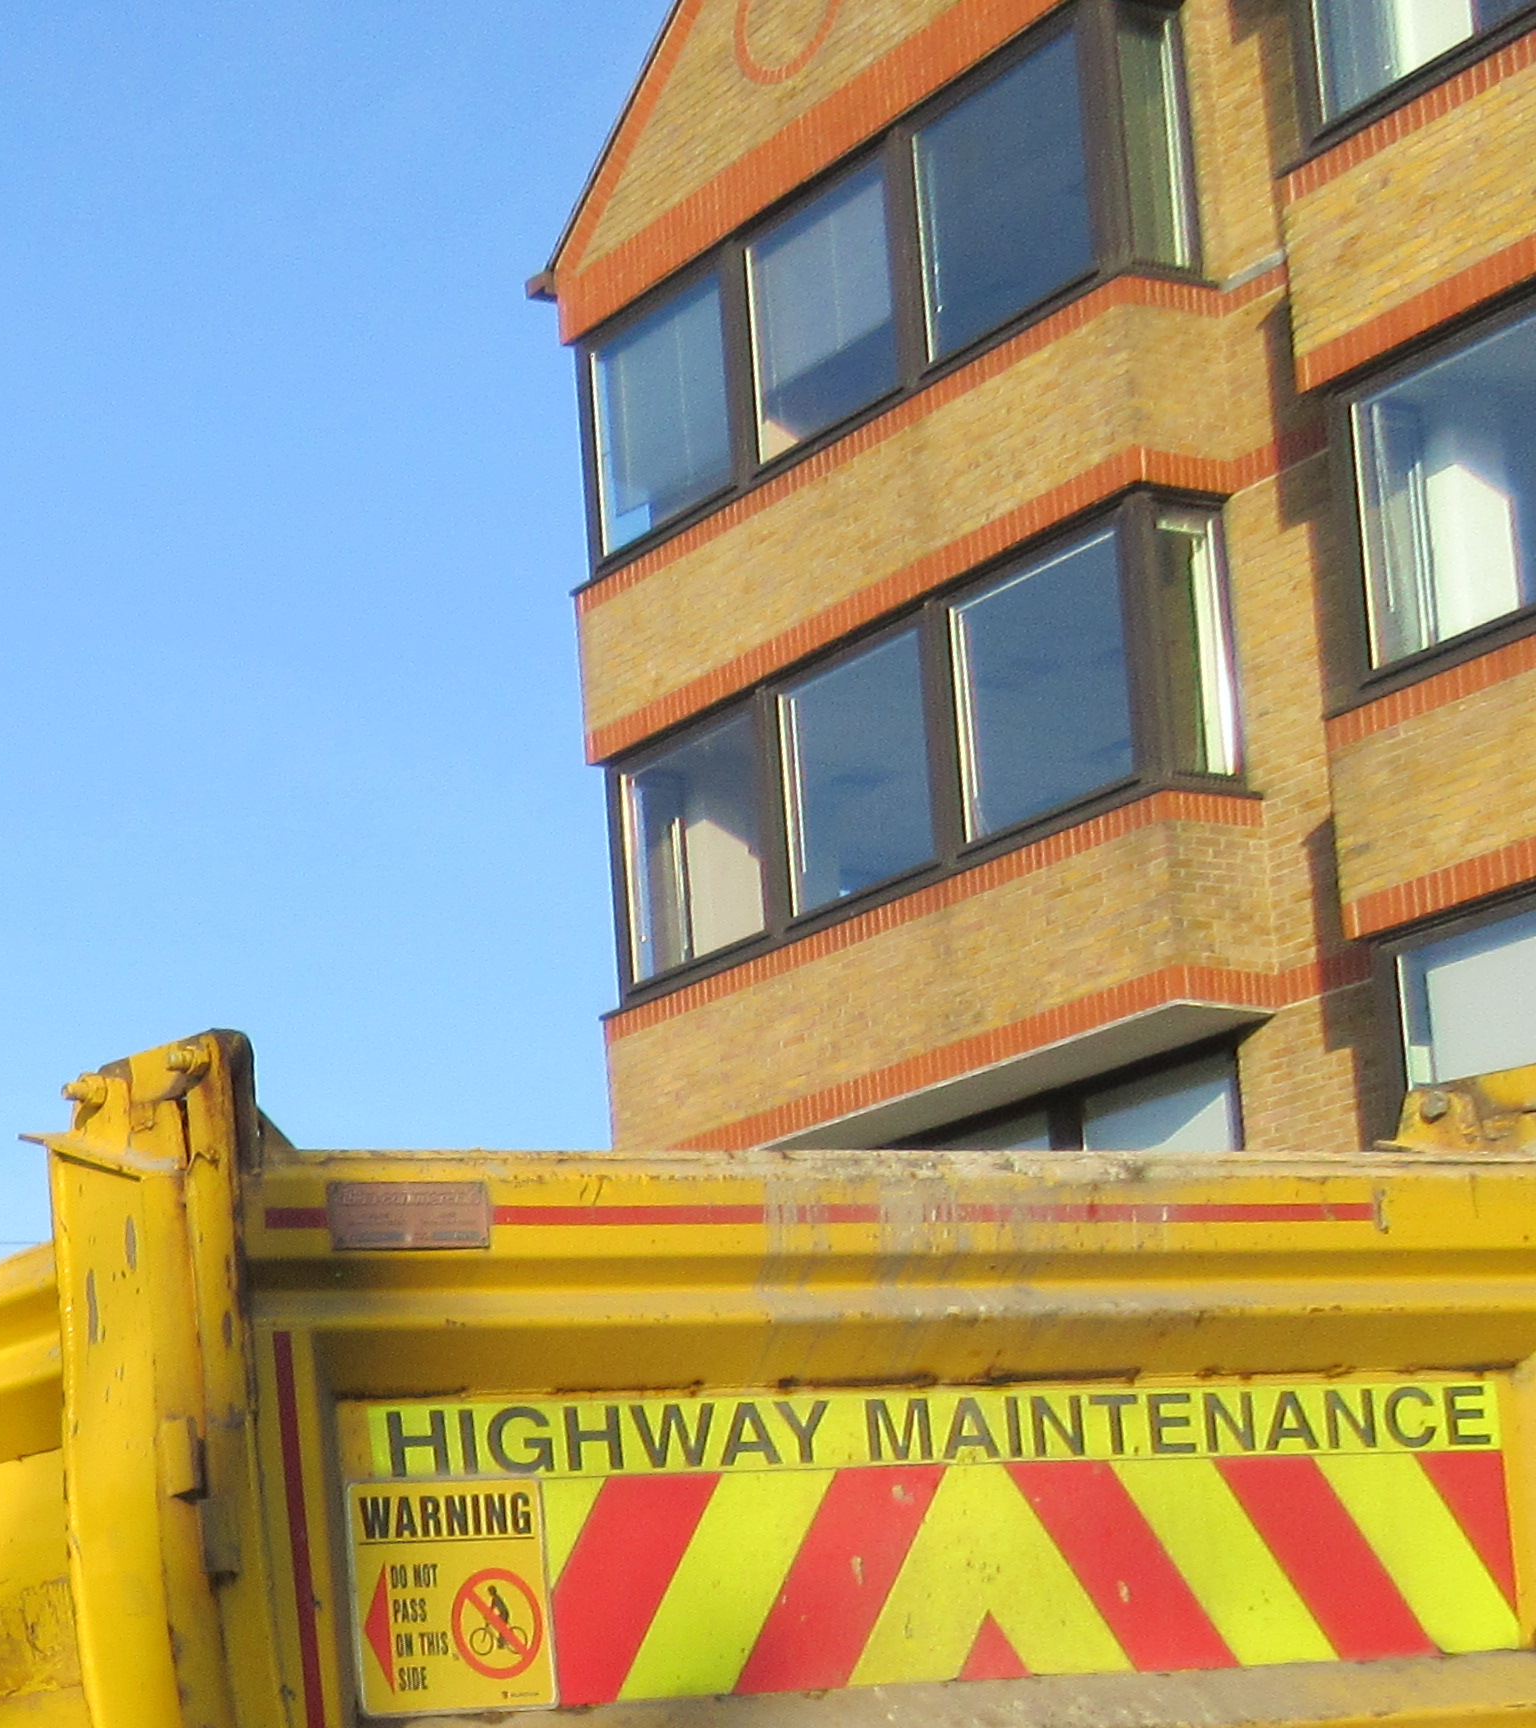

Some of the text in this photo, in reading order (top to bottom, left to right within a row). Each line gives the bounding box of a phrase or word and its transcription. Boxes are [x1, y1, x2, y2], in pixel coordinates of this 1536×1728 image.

[385, 1385, 1493, 1479] HIGHWAY MAINTENANCE
[357, 1491, 532, 1540] WARNING
[390, 1563, 439, 1590] DO NOT
[393, 1597, 428, 1624] PASS
[395, 1631, 449, 1658] ON THIS
[398, 1667, 428, 1692] SIDE
